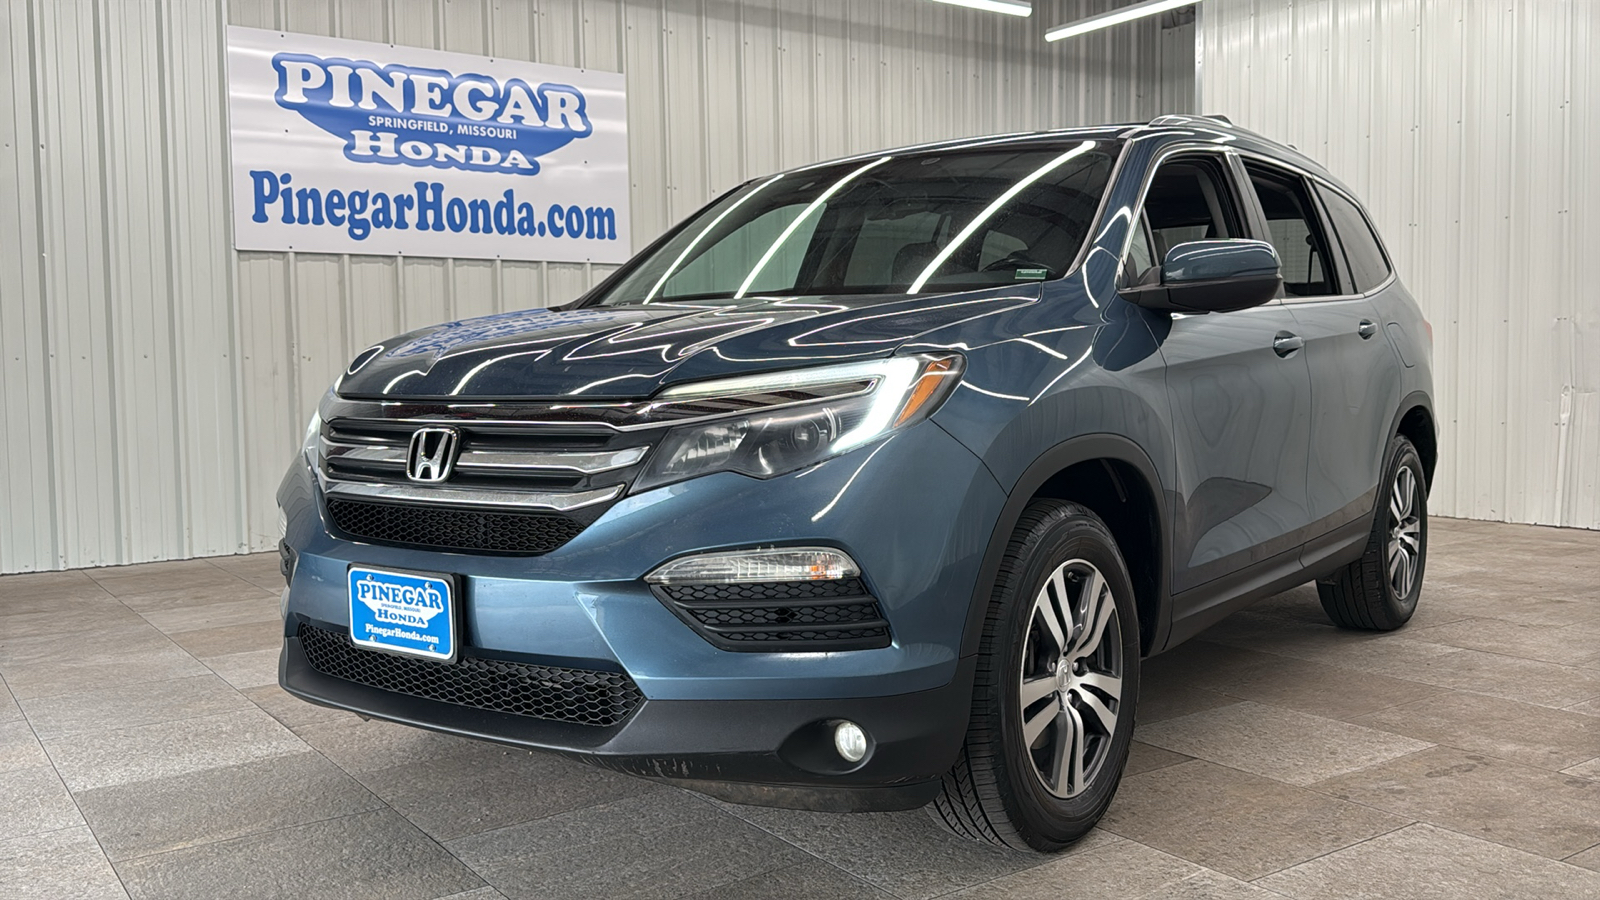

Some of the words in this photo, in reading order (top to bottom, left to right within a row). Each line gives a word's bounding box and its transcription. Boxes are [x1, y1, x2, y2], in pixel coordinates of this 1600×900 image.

[280, 60, 587, 132] PINEGAR
[368, 116, 454, 135] SPRINGFIELD,
[457, 124, 517, 139] MISSOURI
[350, 130, 534, 168] HONDA
[249, 170, 617, 241] PinegarHonda.com
[359, 583, 441, 609] PINEGAR
[377, 608, 426, 625] HONDA
[365, 623, 439, 644] PinegarHonda.com
